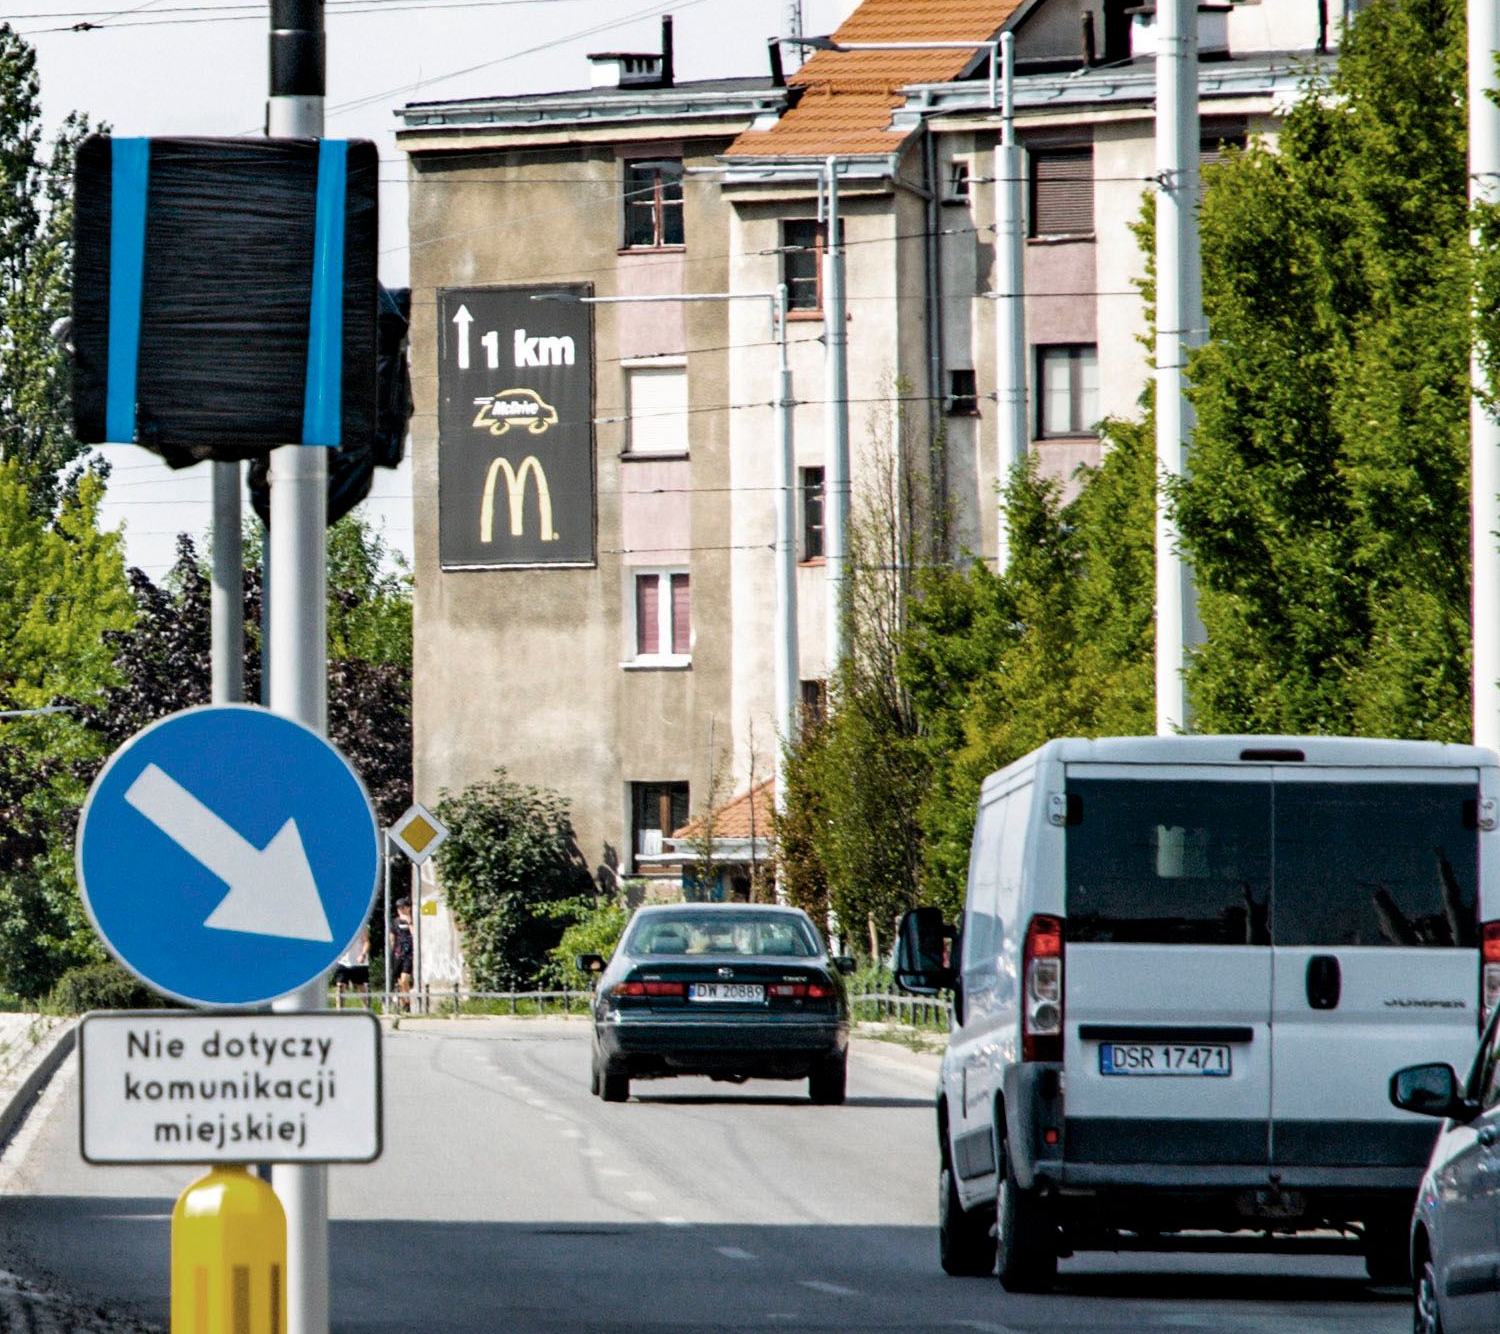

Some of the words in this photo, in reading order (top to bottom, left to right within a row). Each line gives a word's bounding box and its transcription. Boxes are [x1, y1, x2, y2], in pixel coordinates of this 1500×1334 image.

[481, 330, 499, 368] 1
[514, 328, 575, 367] km
[696, 983, 719, 998] DW
[723, 984, 763, 998] 20889
[127, 1030, 184, 1058] Nie
[202, 1030, 333, 1066] dotyczy
[1113, 1046, 1154, 1069] DSR
[1162, 1047, 1226, 1070] 17471
[124, 1071, 336, 1106] komunikacji
[154, 1113, 307, 1149] miejskiej
